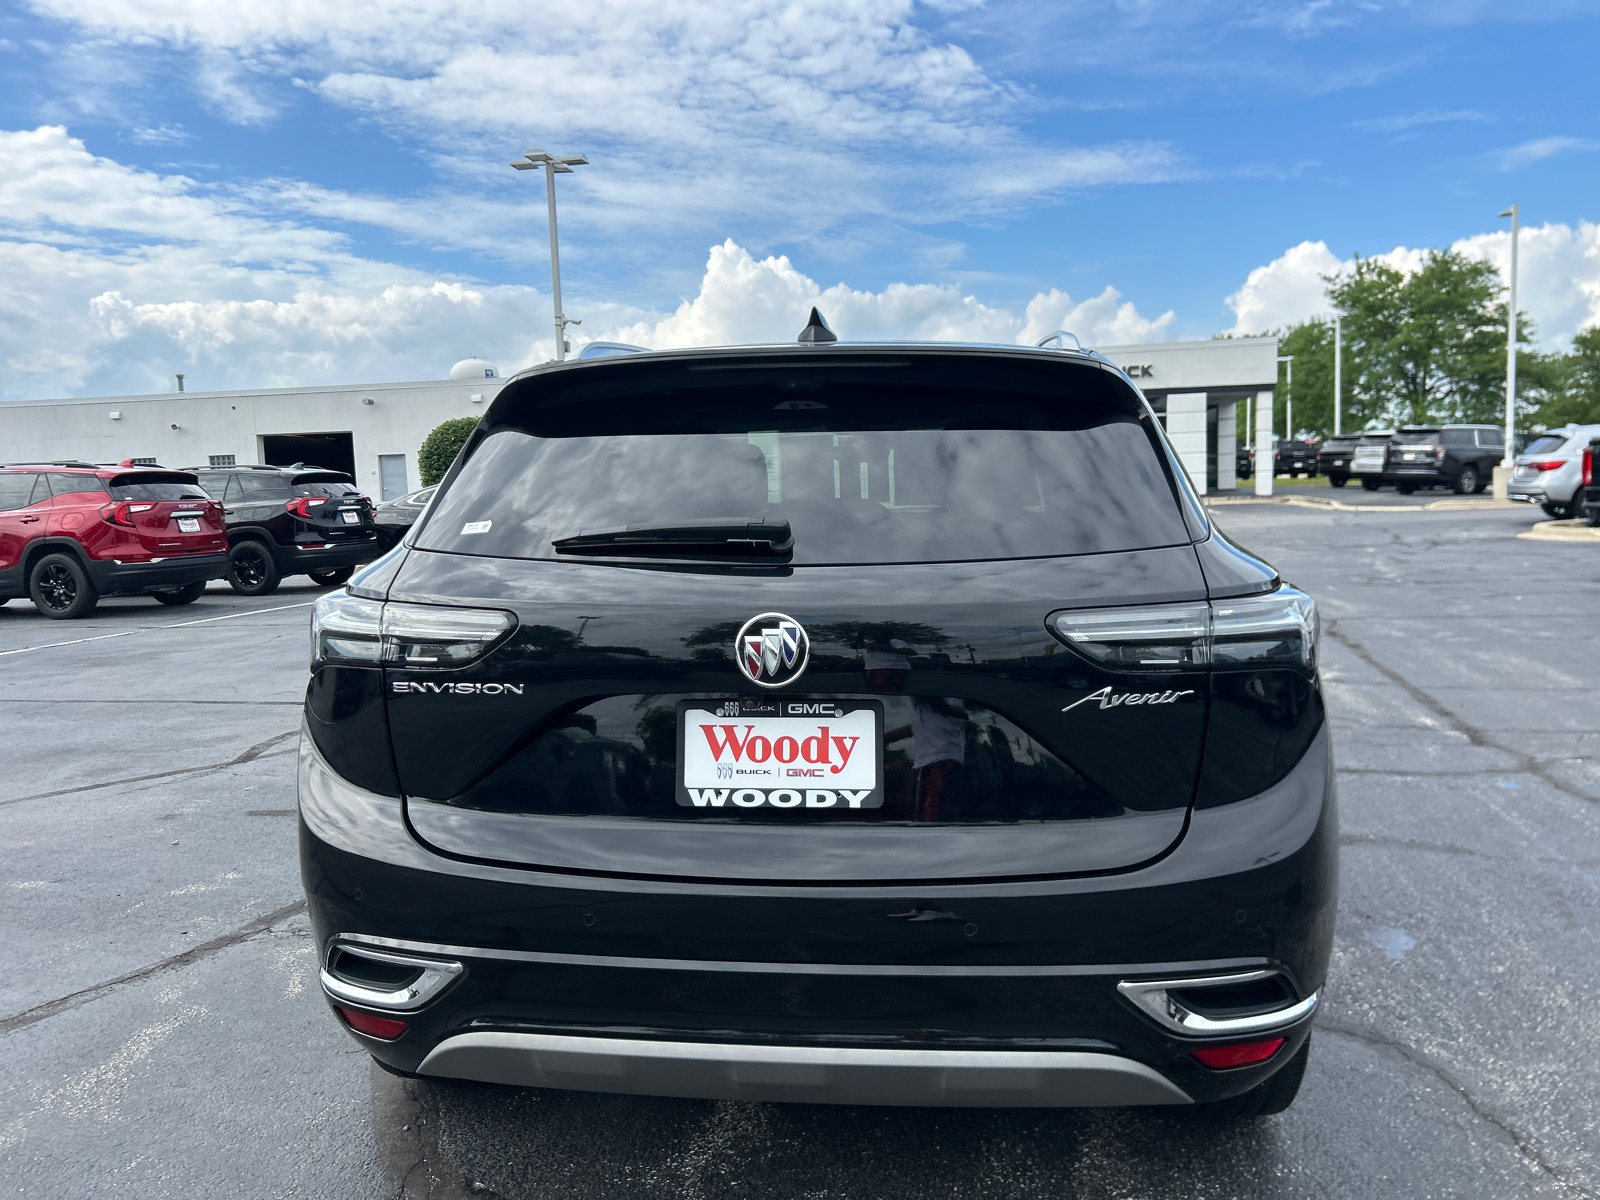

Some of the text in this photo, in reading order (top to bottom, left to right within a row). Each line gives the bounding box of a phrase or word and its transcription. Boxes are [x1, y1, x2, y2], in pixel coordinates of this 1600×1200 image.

[392, 681, 525, 695] ENVISION
[1061, 685, 1195, 712] Avenir
[787, 703, 835, 714] GMC
[699, 724, 860, 774] Woody
[786, 768, 825, 778] GMC
[687, 788, 872, 808] WOODY
